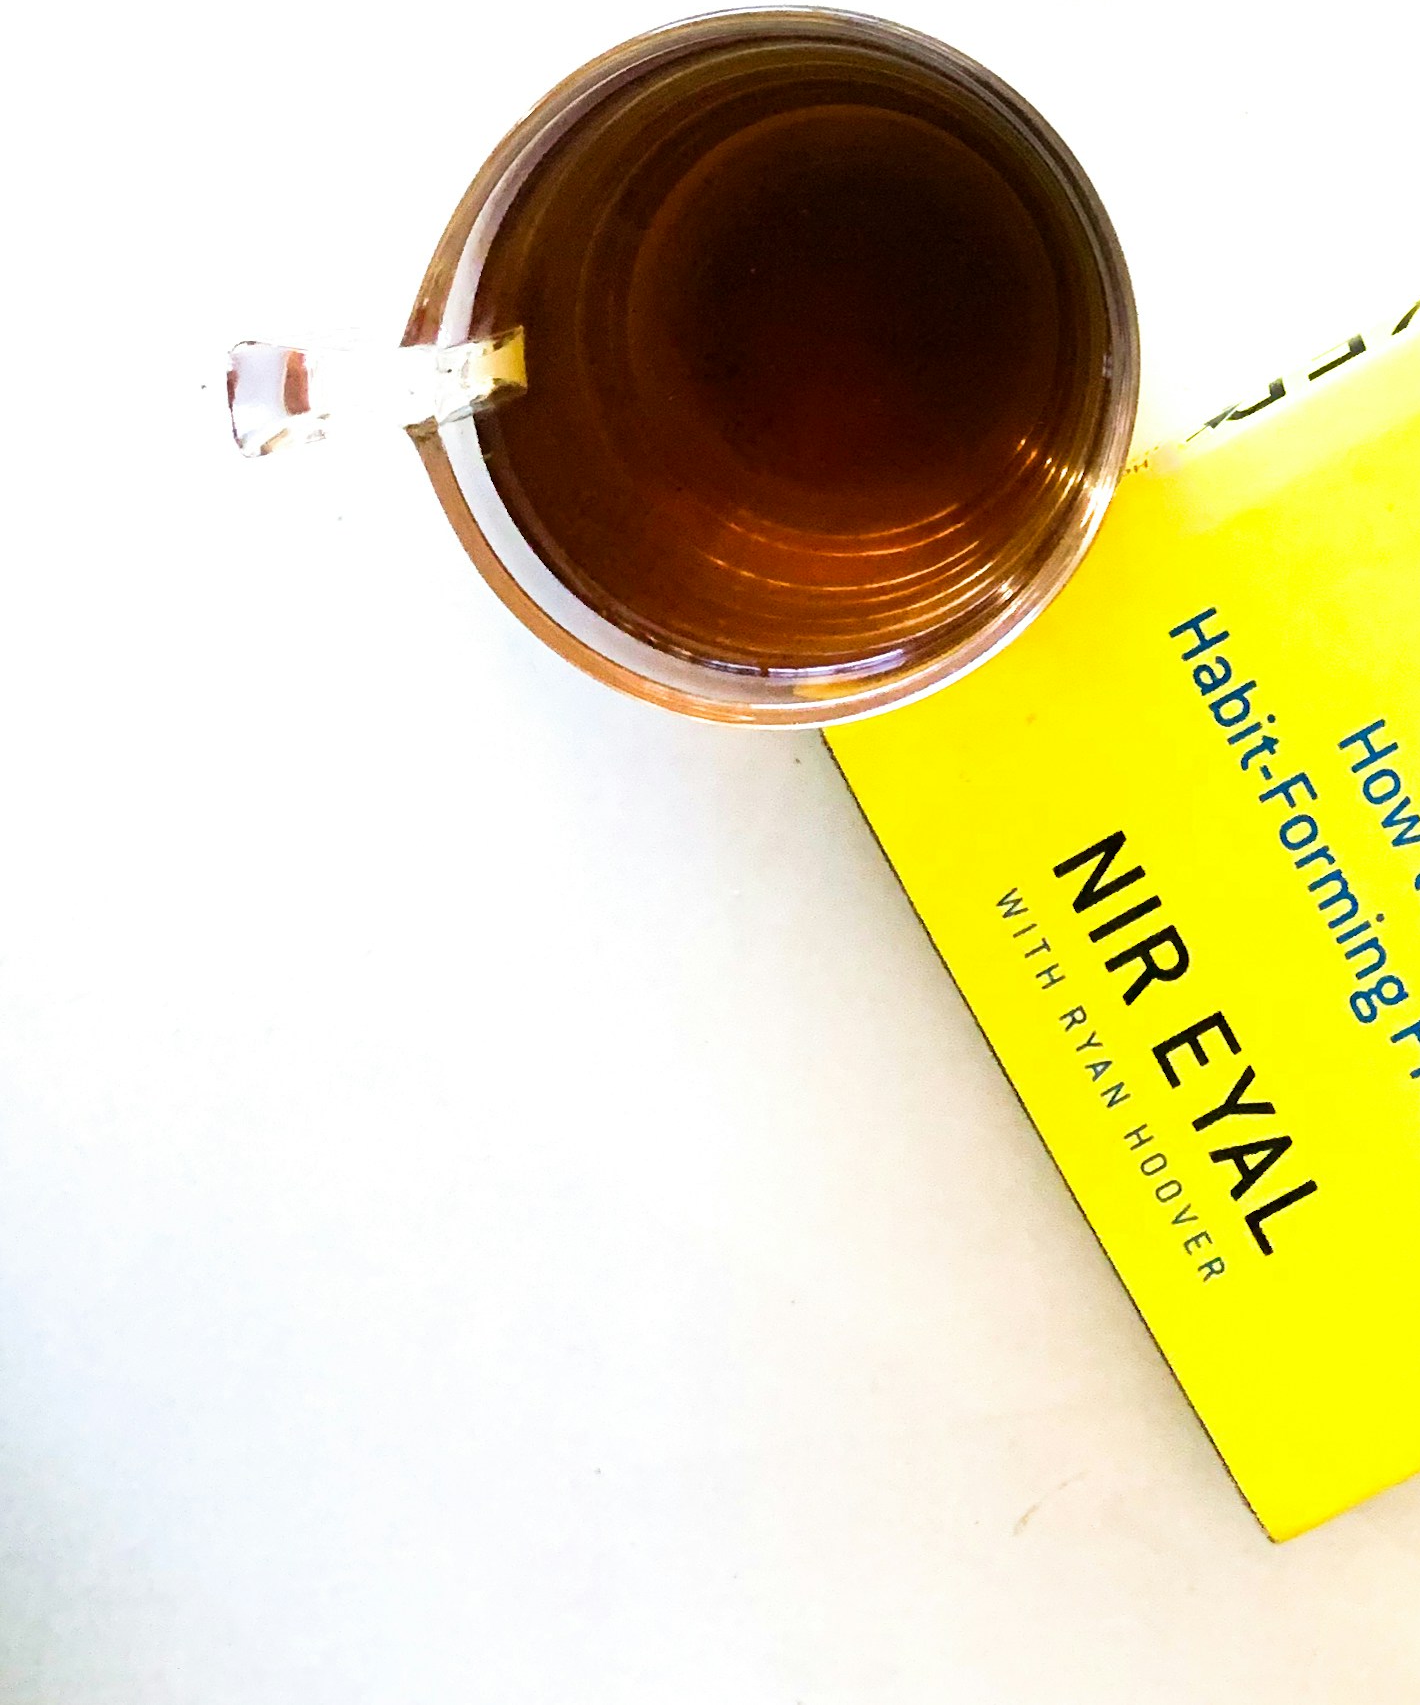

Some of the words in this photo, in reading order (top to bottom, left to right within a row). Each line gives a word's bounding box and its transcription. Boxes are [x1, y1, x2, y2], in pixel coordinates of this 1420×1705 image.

[1168, 607, 1409, 1024] Habit-Forming
[996, 888, 1065, 989] WITH
[1059, 1005, 1130, 1108] RYAN
[1124, 1124, 1225, 1282] HOOVER
[1052, 830, 1190, 1006] NIR
[1151, 1011, 1318, 1256] EYAL
